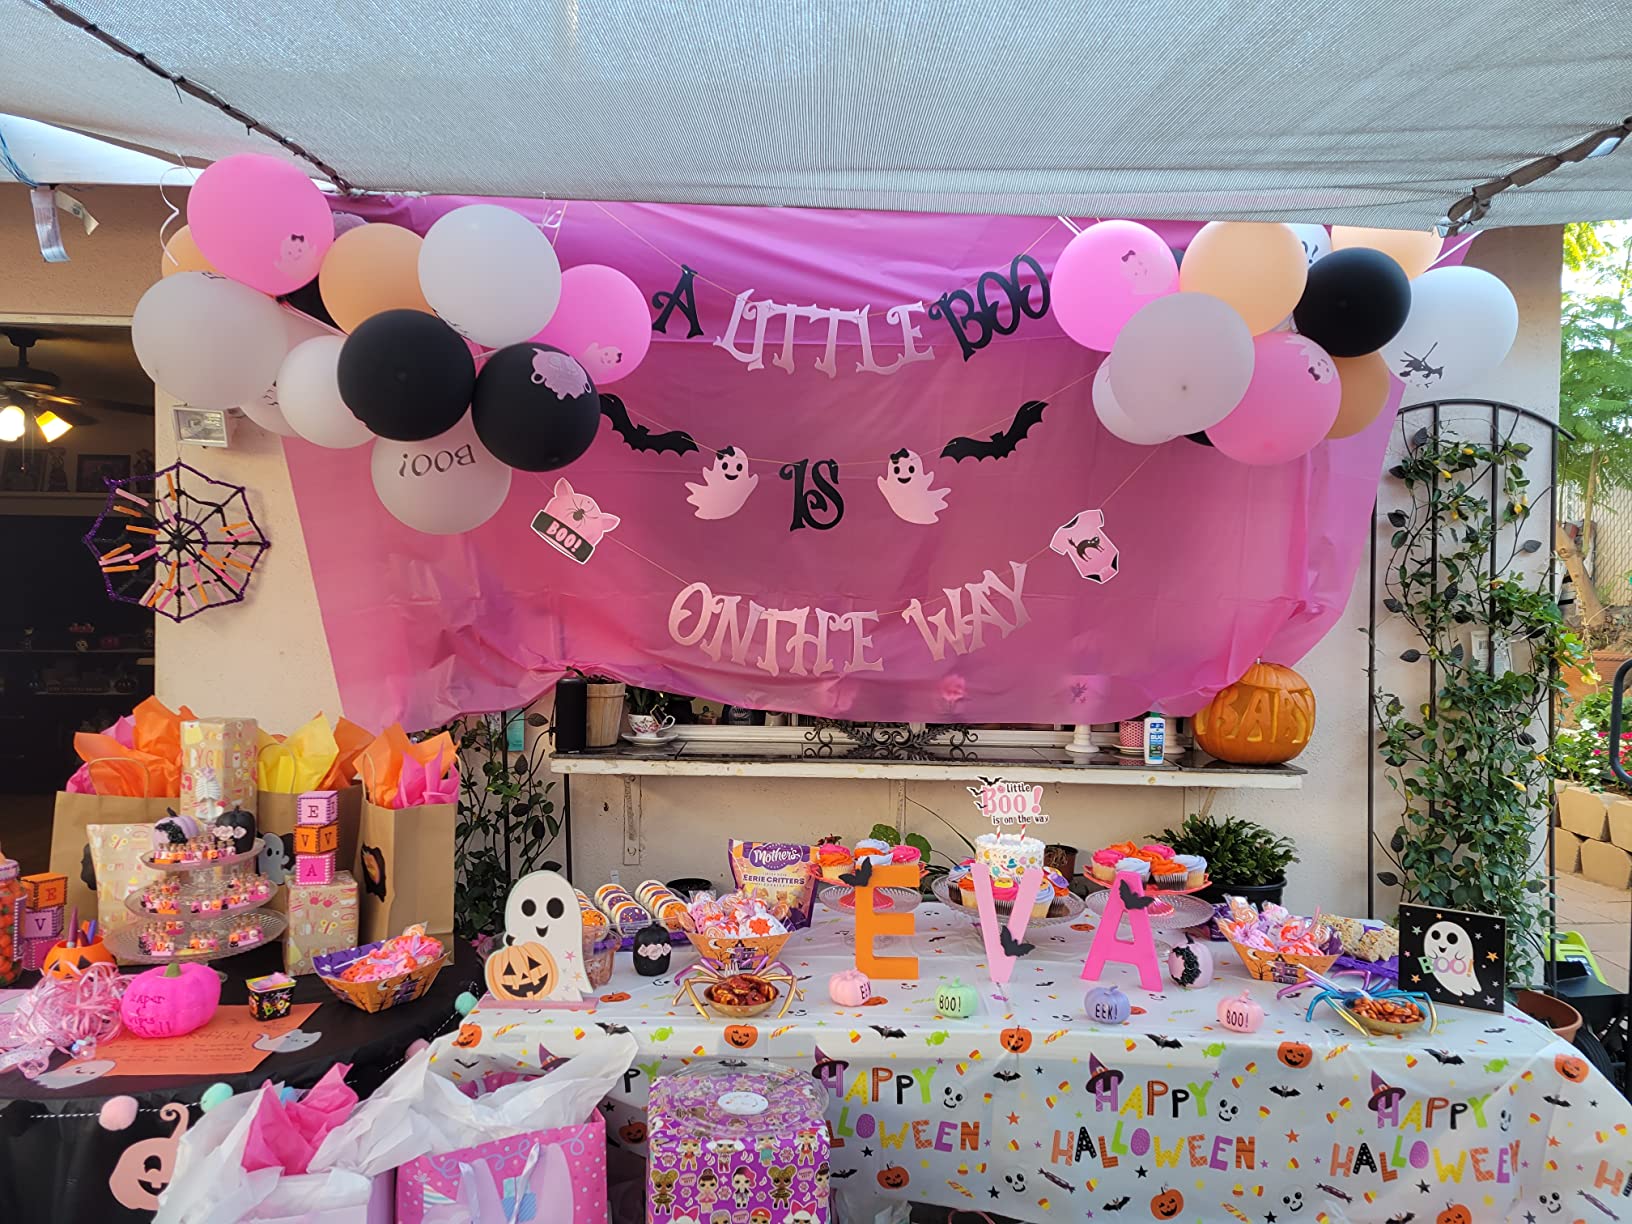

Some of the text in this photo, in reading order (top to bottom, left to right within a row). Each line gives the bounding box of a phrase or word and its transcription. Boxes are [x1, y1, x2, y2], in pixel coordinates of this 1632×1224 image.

[652, 254, 1050, 378] A LITTLE BOO
[398, 444, 477, 477] BOO!
[779, 458, 845, 532] IS
[546, 519, 583, 553] BOO!
[902, 561, 1031, 661] WAY
[1006, 783, 1031, 793] little
[307, 805, 319, 818] E
[992, 814, 1049, 824] is on the way
[753, 847, 801, 865] Mother's
[306, 863, 318, 877] A
[743, 874, 766, 883] EERIE
[766, 876, 805, 885] CRITTERS
[45, 887, 57, 901] E
[34, 918, 47, 931] V
[1417, 956, 1475, 977] BOO!
[938, 994, 962, 1012] BOO!
[1095, 1003, 1118, 1021] EEK!
[1226, 1009, 1249, 1029] BOO!
[820, 1063, 938, 1107] HAPPY
[1095, 1076, 1214, 1120] HAPPY
[1377, 1092, 1493, 1133] HAPPY
[825, 1106, 980, 1153] LLOWEEN
[1051, 1120, 1256, 1172] HALLOWEEN
